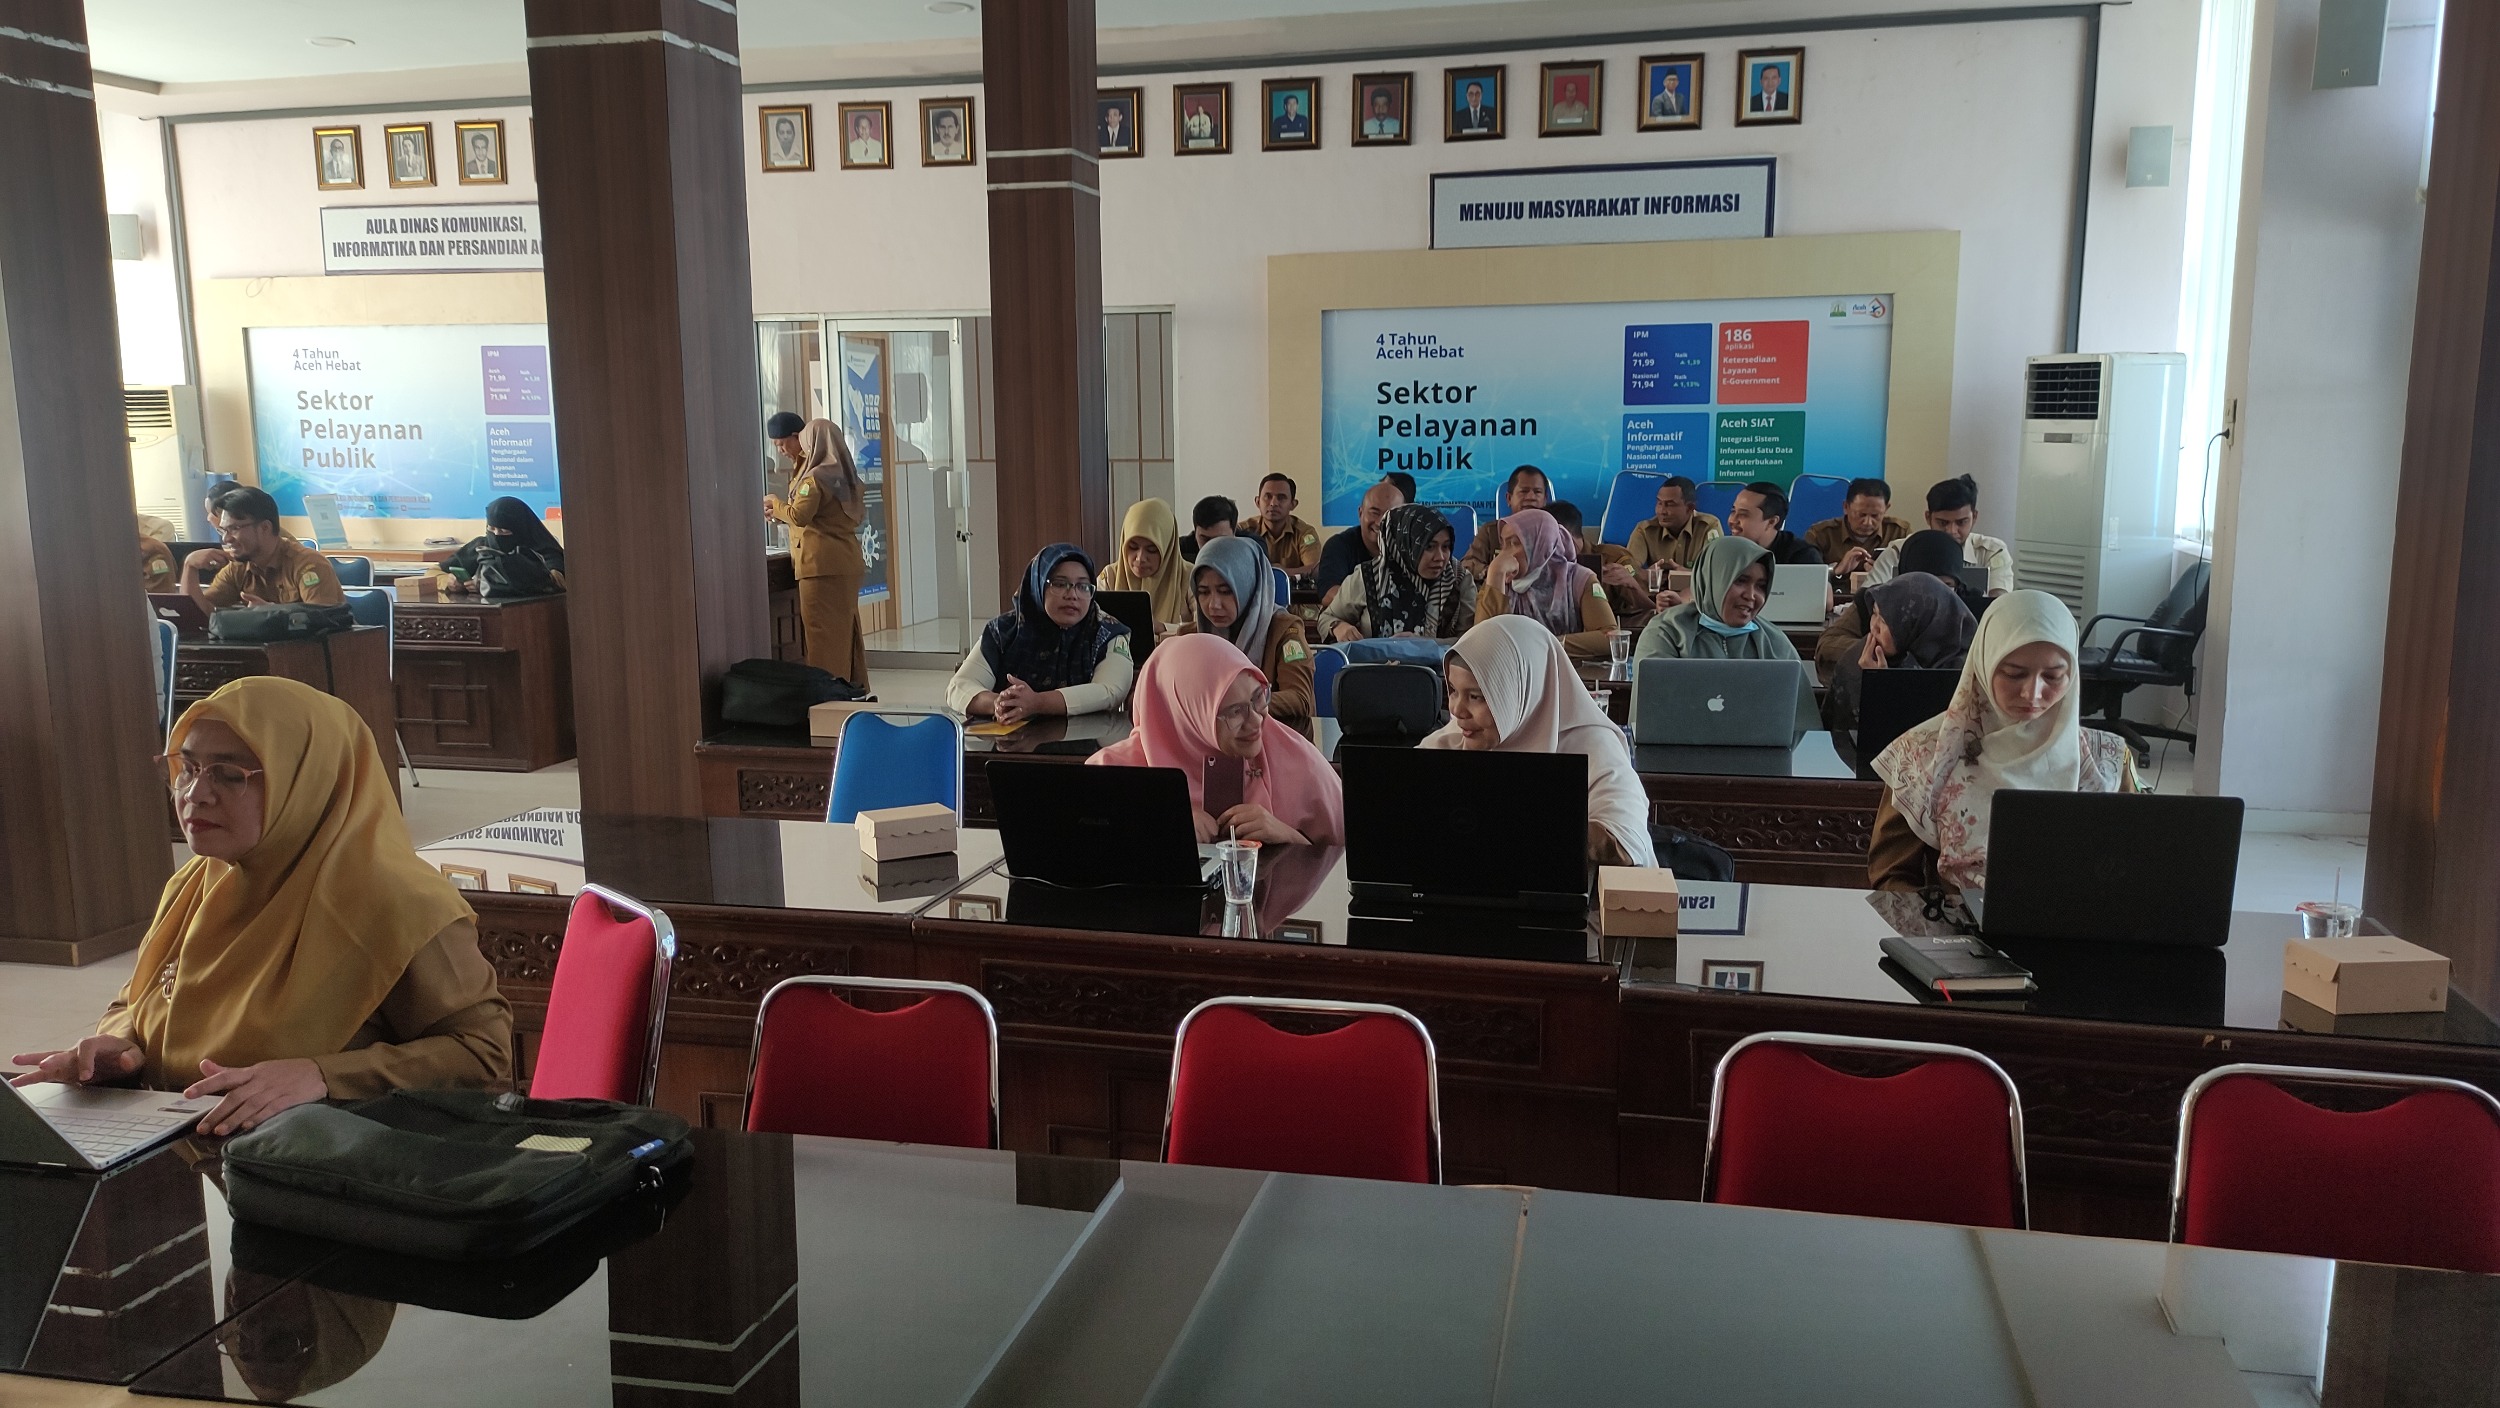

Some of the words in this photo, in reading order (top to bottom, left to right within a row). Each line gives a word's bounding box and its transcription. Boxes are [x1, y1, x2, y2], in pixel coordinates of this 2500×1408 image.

[1459, 201, 1524, 221] MENUJU
[1528, 197, 1640, 219] MASYARAKAT
[1643, 193, 1740, 215] INFORMASI
[366, 218, 398, 234] AULA
[400, 217, 438, 234] DINAS
[441, 216, 527, 233] KOMUNIKASI,
[333, 240, 417, 258] INFORMATIKA
[420, 240, 445, 256] DAN
[448, 239, 528, 256] PERSANDIAN
[531, 239, 543, 255] A
[1376, 333, 1385, 345] 4
[1389, 332, 1437, 345] Tahun
[1724, 329, 1752, 342] 186
[1376, 346, 1413, 359] Aceh
[1418, 345, 1464, 358] Hebat
[1725, 343, 1754, 351] aplikasi
[293, 349, 299, 359] 4
[302, 348, 339, 359] Tahun
[294, 360, 322, 371] Aceh
[326, 360, 361, 371] Hebat
[1633, 359, 1655, 367] 71,99
[1723, 356, 1776, 364] Ketersediaan
[1722, 367, 1757, 376] Layanan
[1632, 381, 1654, 389] 71,94
[1722, 377, 1780, 385] E-Government
[1377, 380, 1477, 404] Sektor
[297, 389, 374, 410] Sektor
[1378, 413, 1537, 444] Pelayanan
[1627, 420, 1654, 429] Aceh
[1721, 418, 1748, 428] Aceh
[1751, 418, 1775, 428] SIAT
[300, 418, 423, 445] Pelayanan
[490, 427, 510, 436] Aceh
[1627, 431, 1684, 442] Informatif
[490, 438, 533, 447] Informatif
[1720, 436, 1753, 444] Integrasi
[1626, 444, 1674, 452] Penghargaan
[302, 447, 376, 469] Publik
[1378, 446, 1473, 470] Publik
